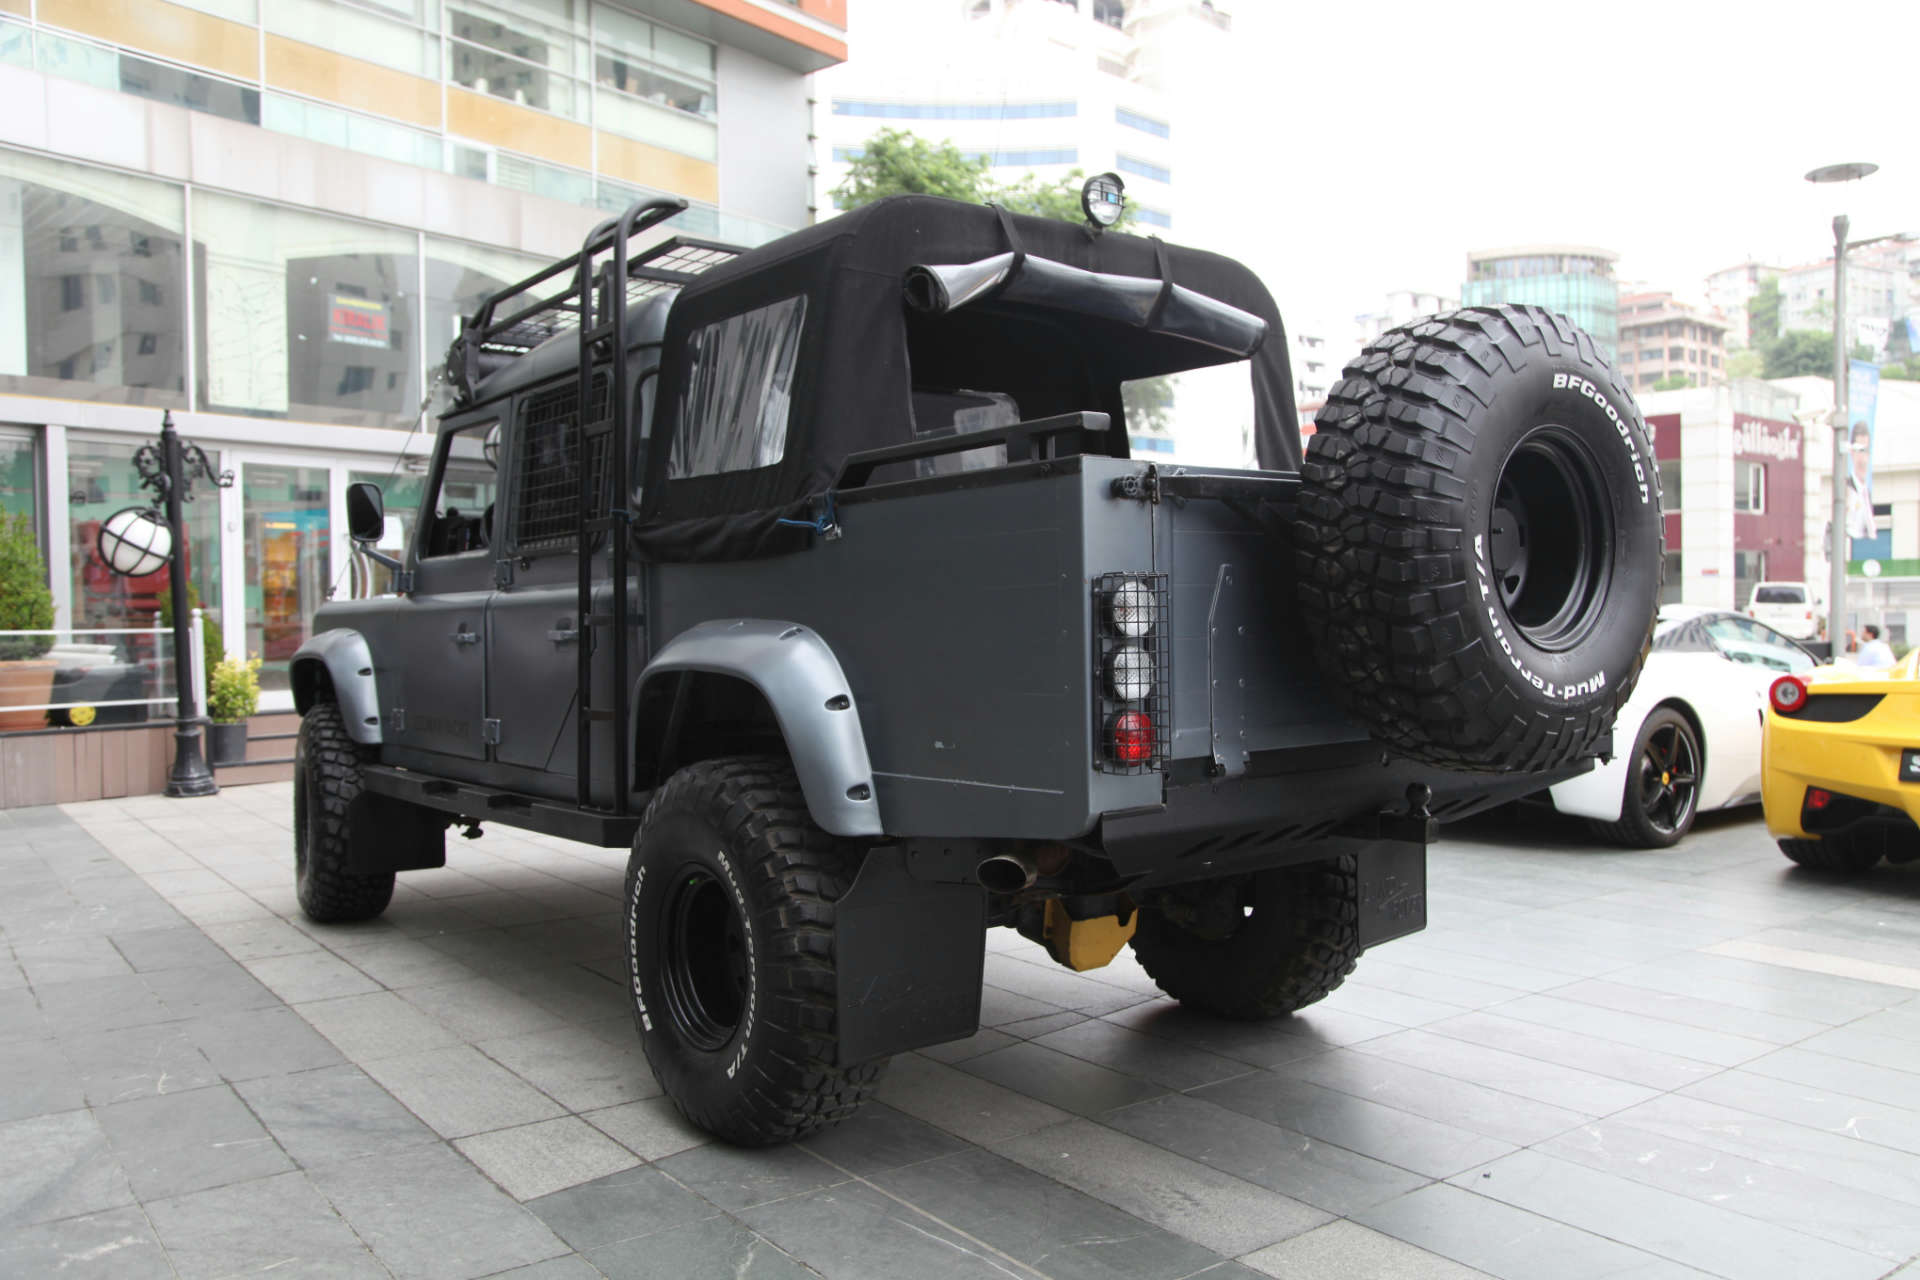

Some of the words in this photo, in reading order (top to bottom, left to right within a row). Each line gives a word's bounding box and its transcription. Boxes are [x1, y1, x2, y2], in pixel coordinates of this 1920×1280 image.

[1553, 373, 1649, 504] BFGoodrich
[1474, 534, 1489, 601] T/A
[630, 865, 653, 1032] BFGoodrich
[717, 851, 756, 1038] Mud-Terrain
[726, 1042, 748, 1079] T/A
